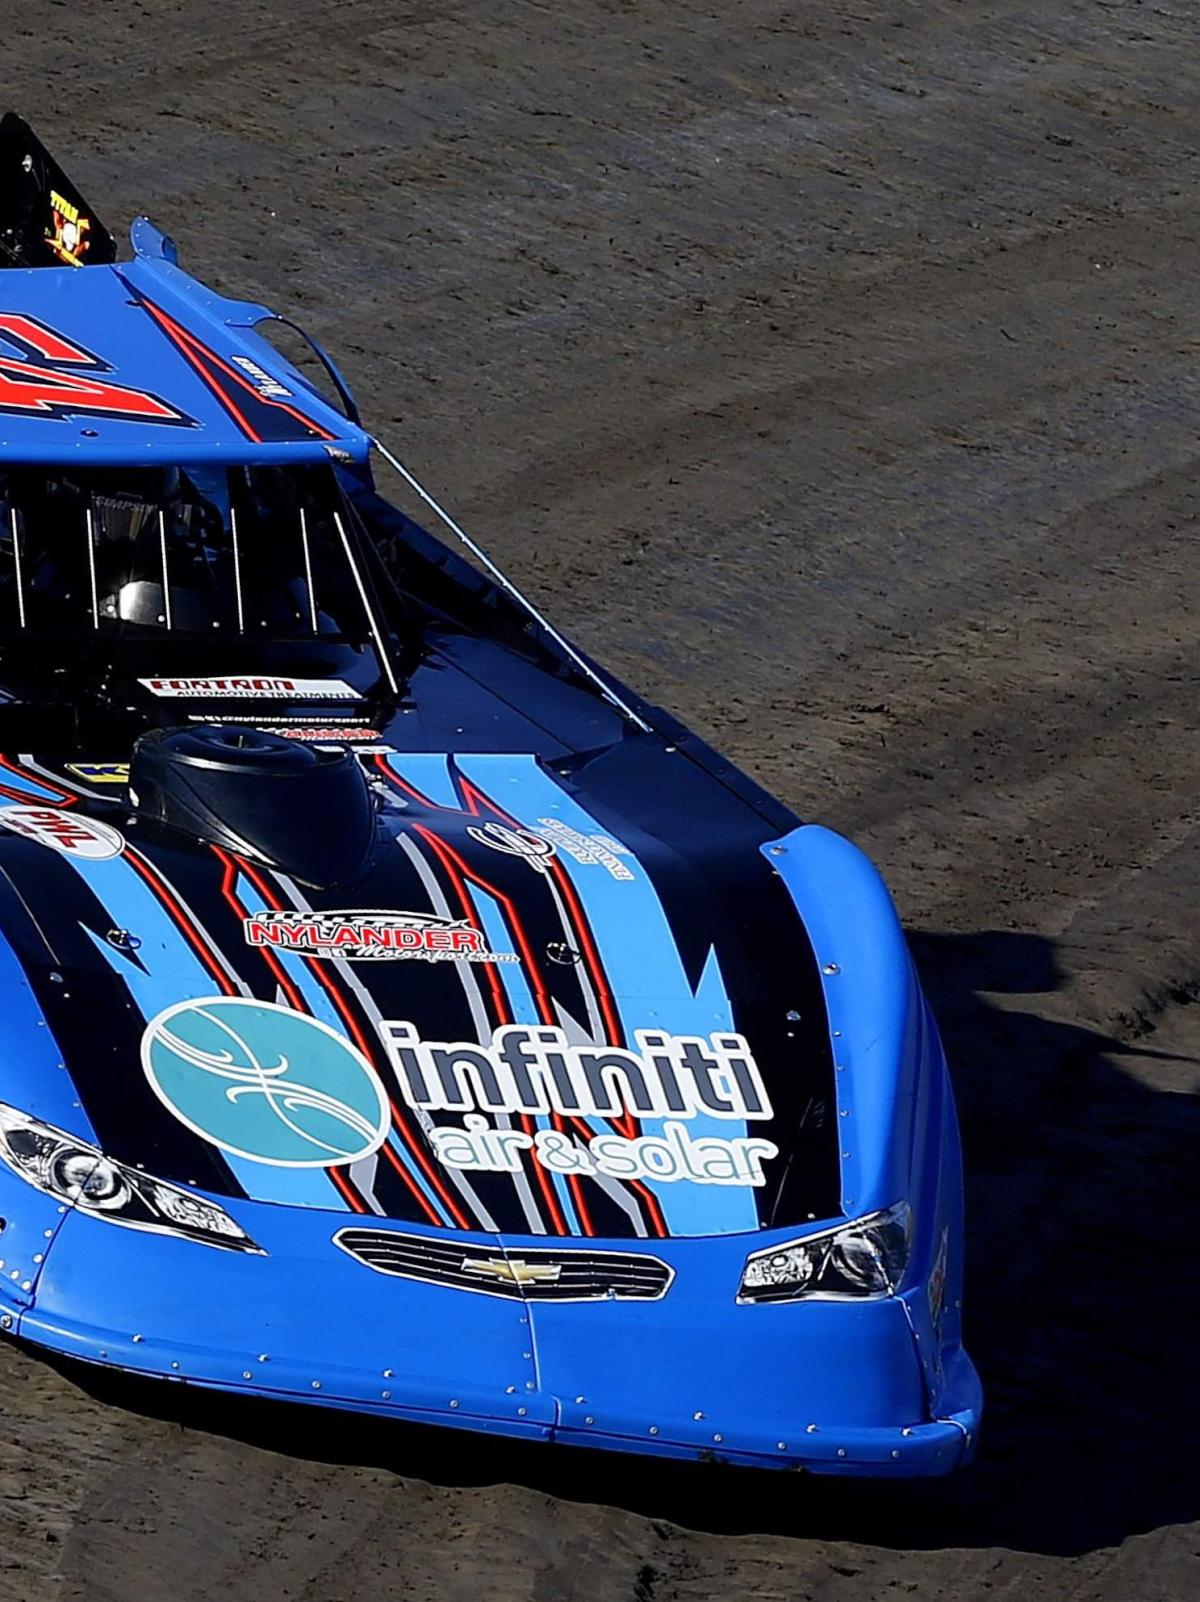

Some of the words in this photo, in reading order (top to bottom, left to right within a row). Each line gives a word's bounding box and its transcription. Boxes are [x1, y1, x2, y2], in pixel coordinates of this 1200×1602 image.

[150, 680, 295, 691] FORTRON
[10, 811, 99, 848] PWL
[250, 922, 480, 951] NYLANDER
[388, 1026, 765, 1115] infiniti
[431, 1117, 531, 1171] air
[537, 1132, 595, 1173] &
[593, 1124, 776, 1184] solar
